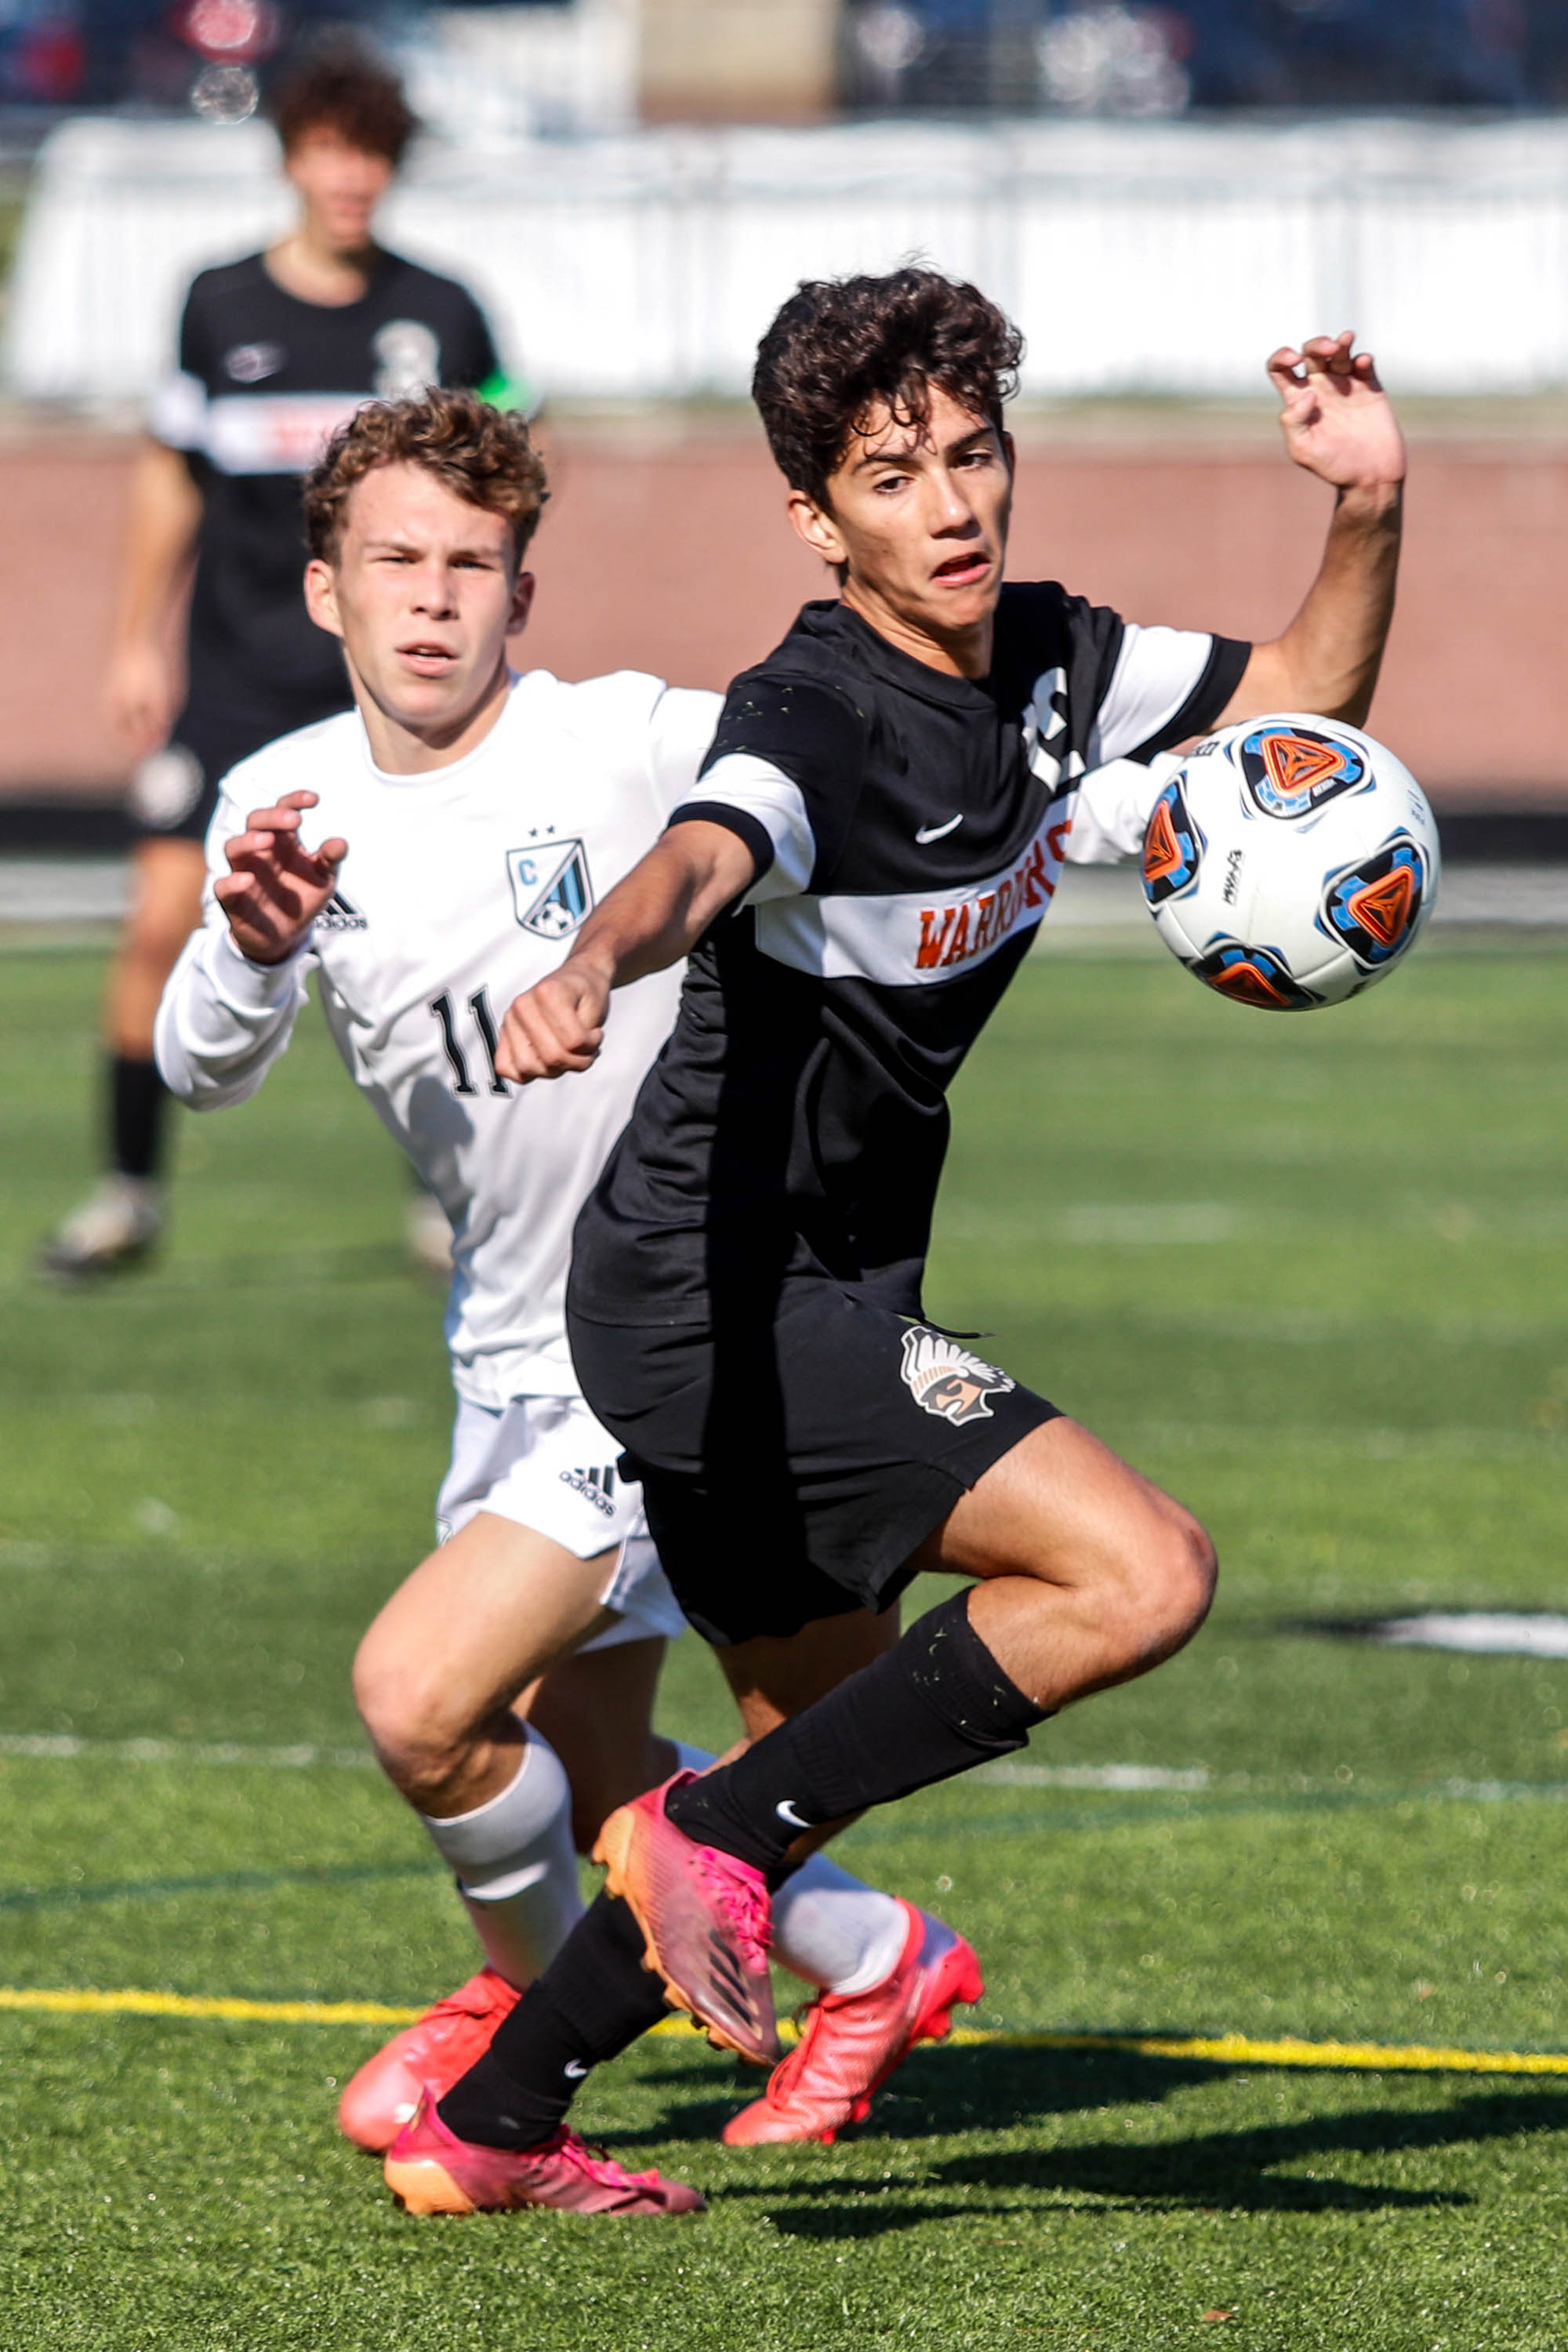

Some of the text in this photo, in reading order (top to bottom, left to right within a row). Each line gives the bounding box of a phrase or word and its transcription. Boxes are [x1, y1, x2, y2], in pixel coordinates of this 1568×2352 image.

[518, 859, 539, 886] C
[915, 818, 1073, 970] WARRRS
[314, 915, 368, 931] didas
[429, 983, 512, 1098] 11
[558, 1470, 616, 1518] adidas
